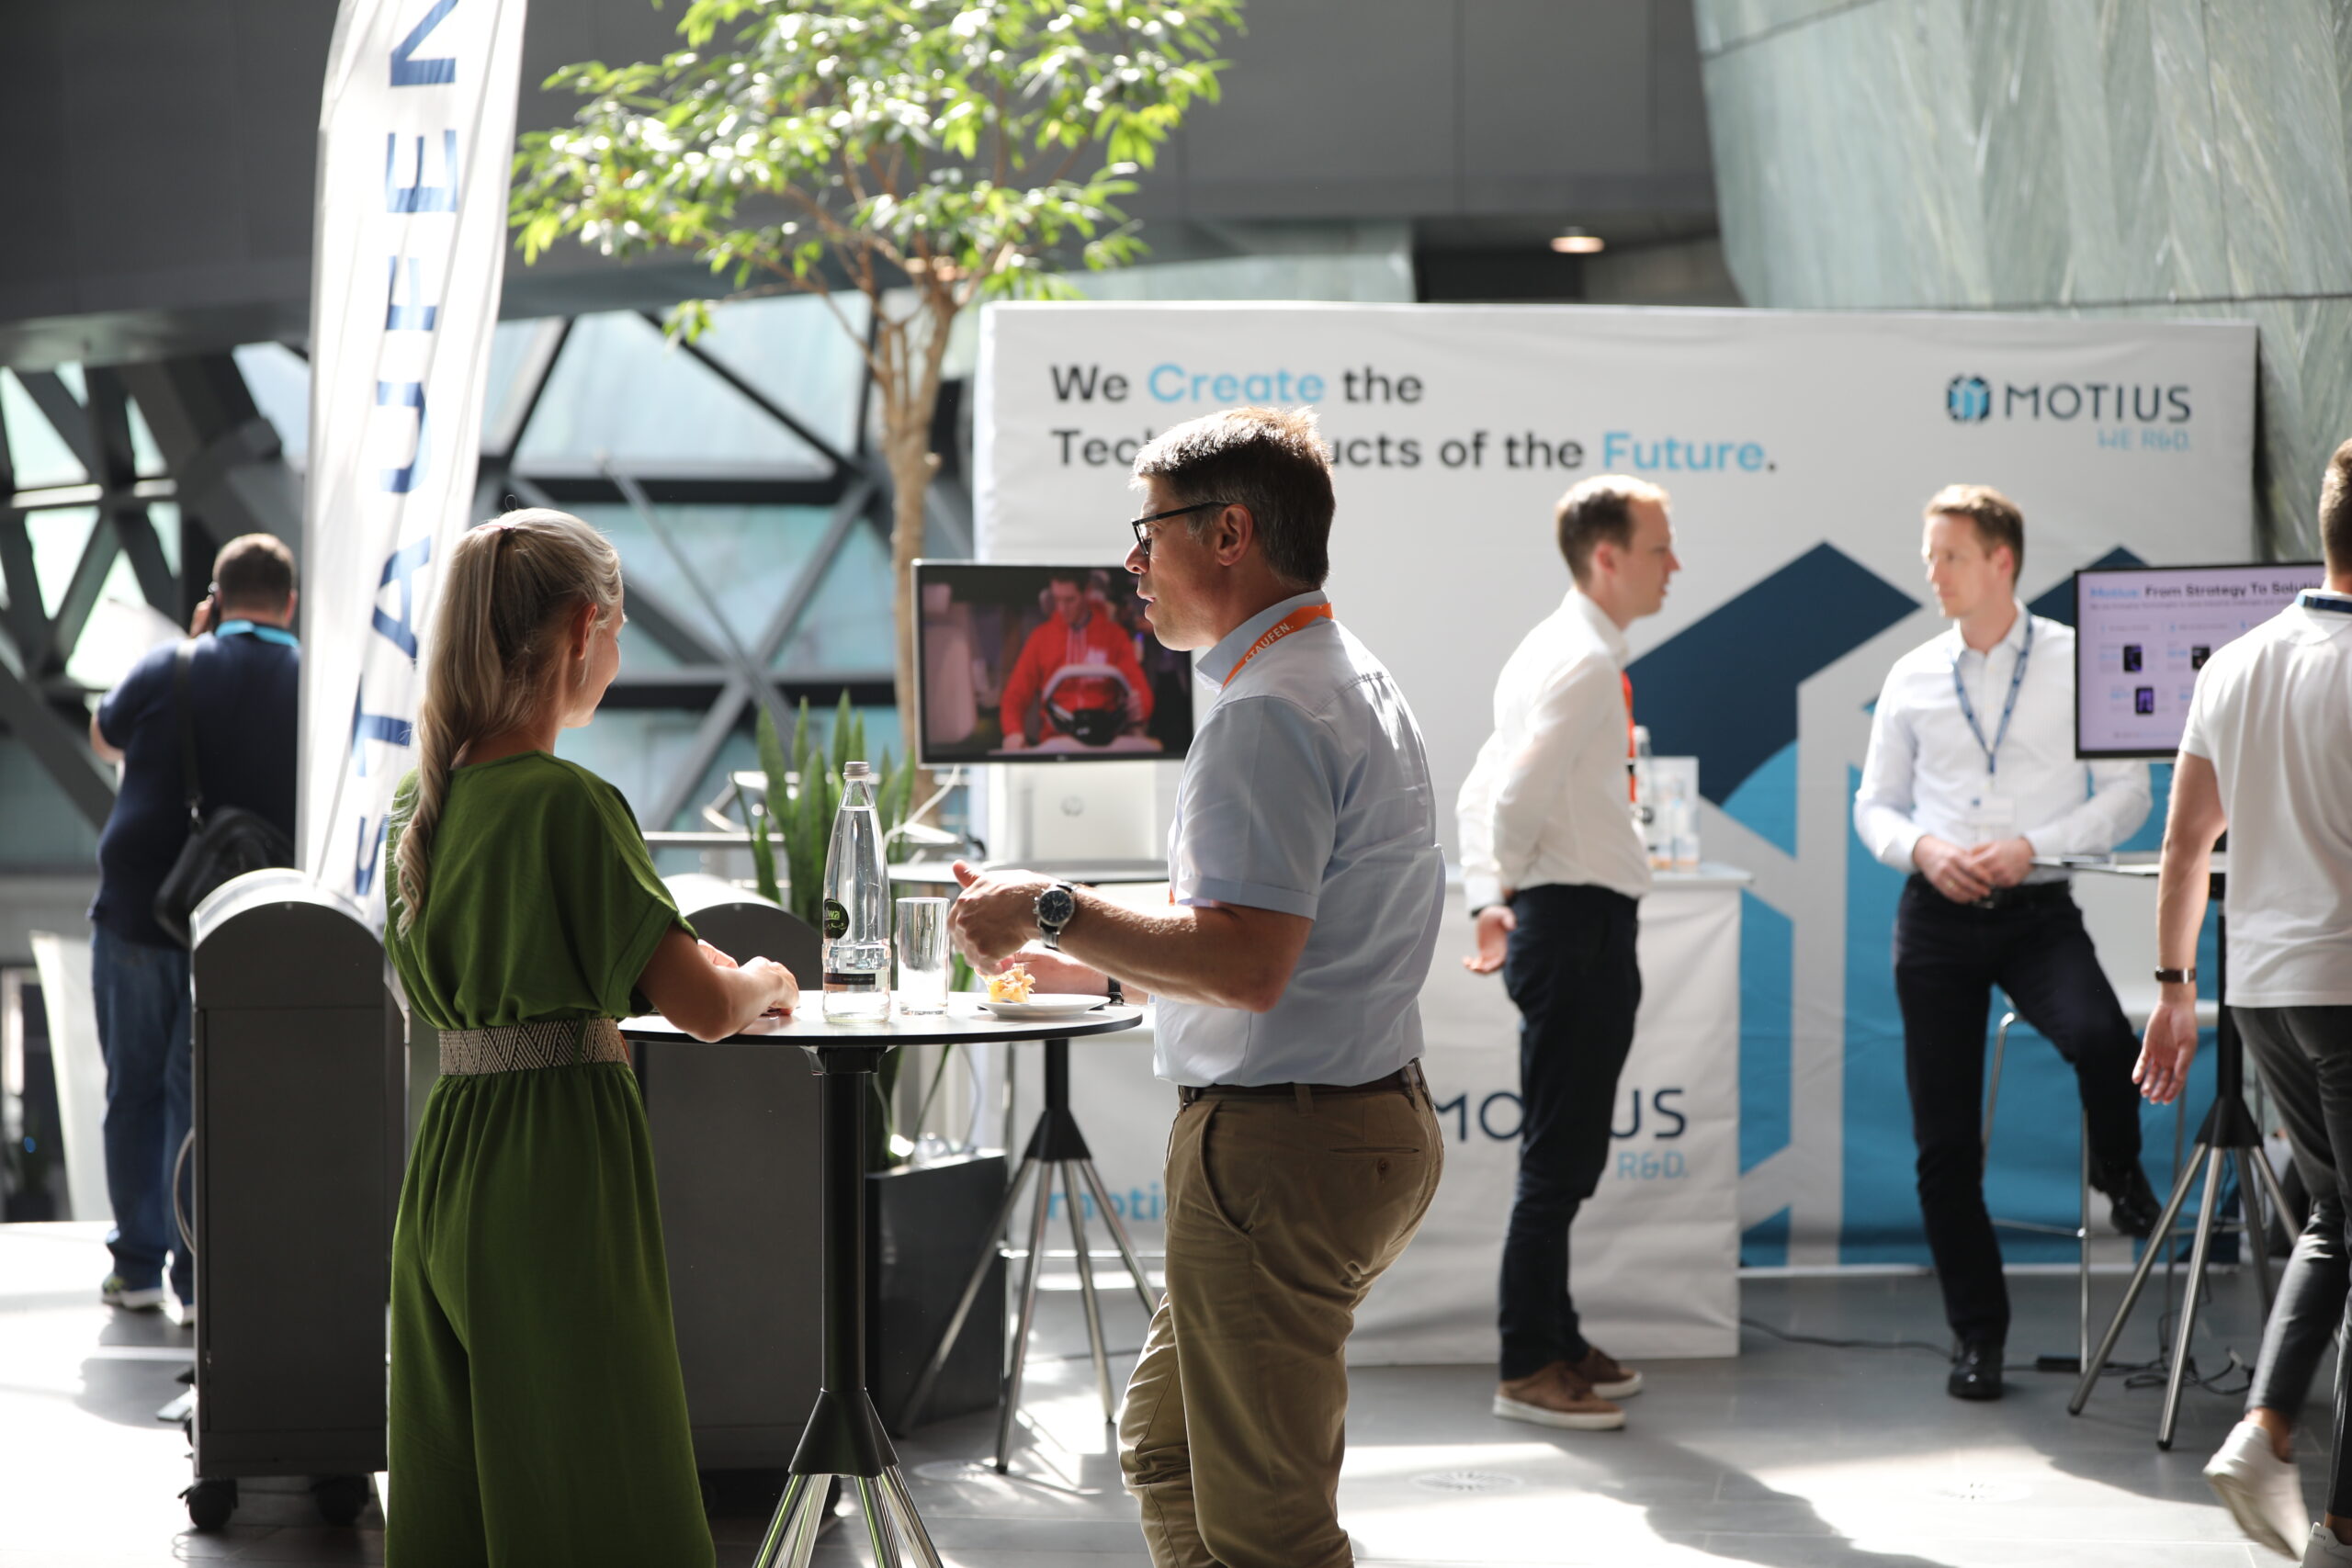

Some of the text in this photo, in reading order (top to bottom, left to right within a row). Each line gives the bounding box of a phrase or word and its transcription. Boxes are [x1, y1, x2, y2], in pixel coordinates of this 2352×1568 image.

[1051, 363, 1423, 403] We Create the
[2005, 382, 2192, 423] MOTIUS
[1439, 430, 1487, 468] of
[1505, 430, 1584, 468] the
[1602, 431, 1777, 471] Future.
[2144, 584, 2183, 597] From
[2186, 582, 2246, 598] Strategy
[2250, 582, 2267, 595] To
[1432, 1089, 1687, 1142] MOUS
[1047, 1182, 1166, 1220] moti
